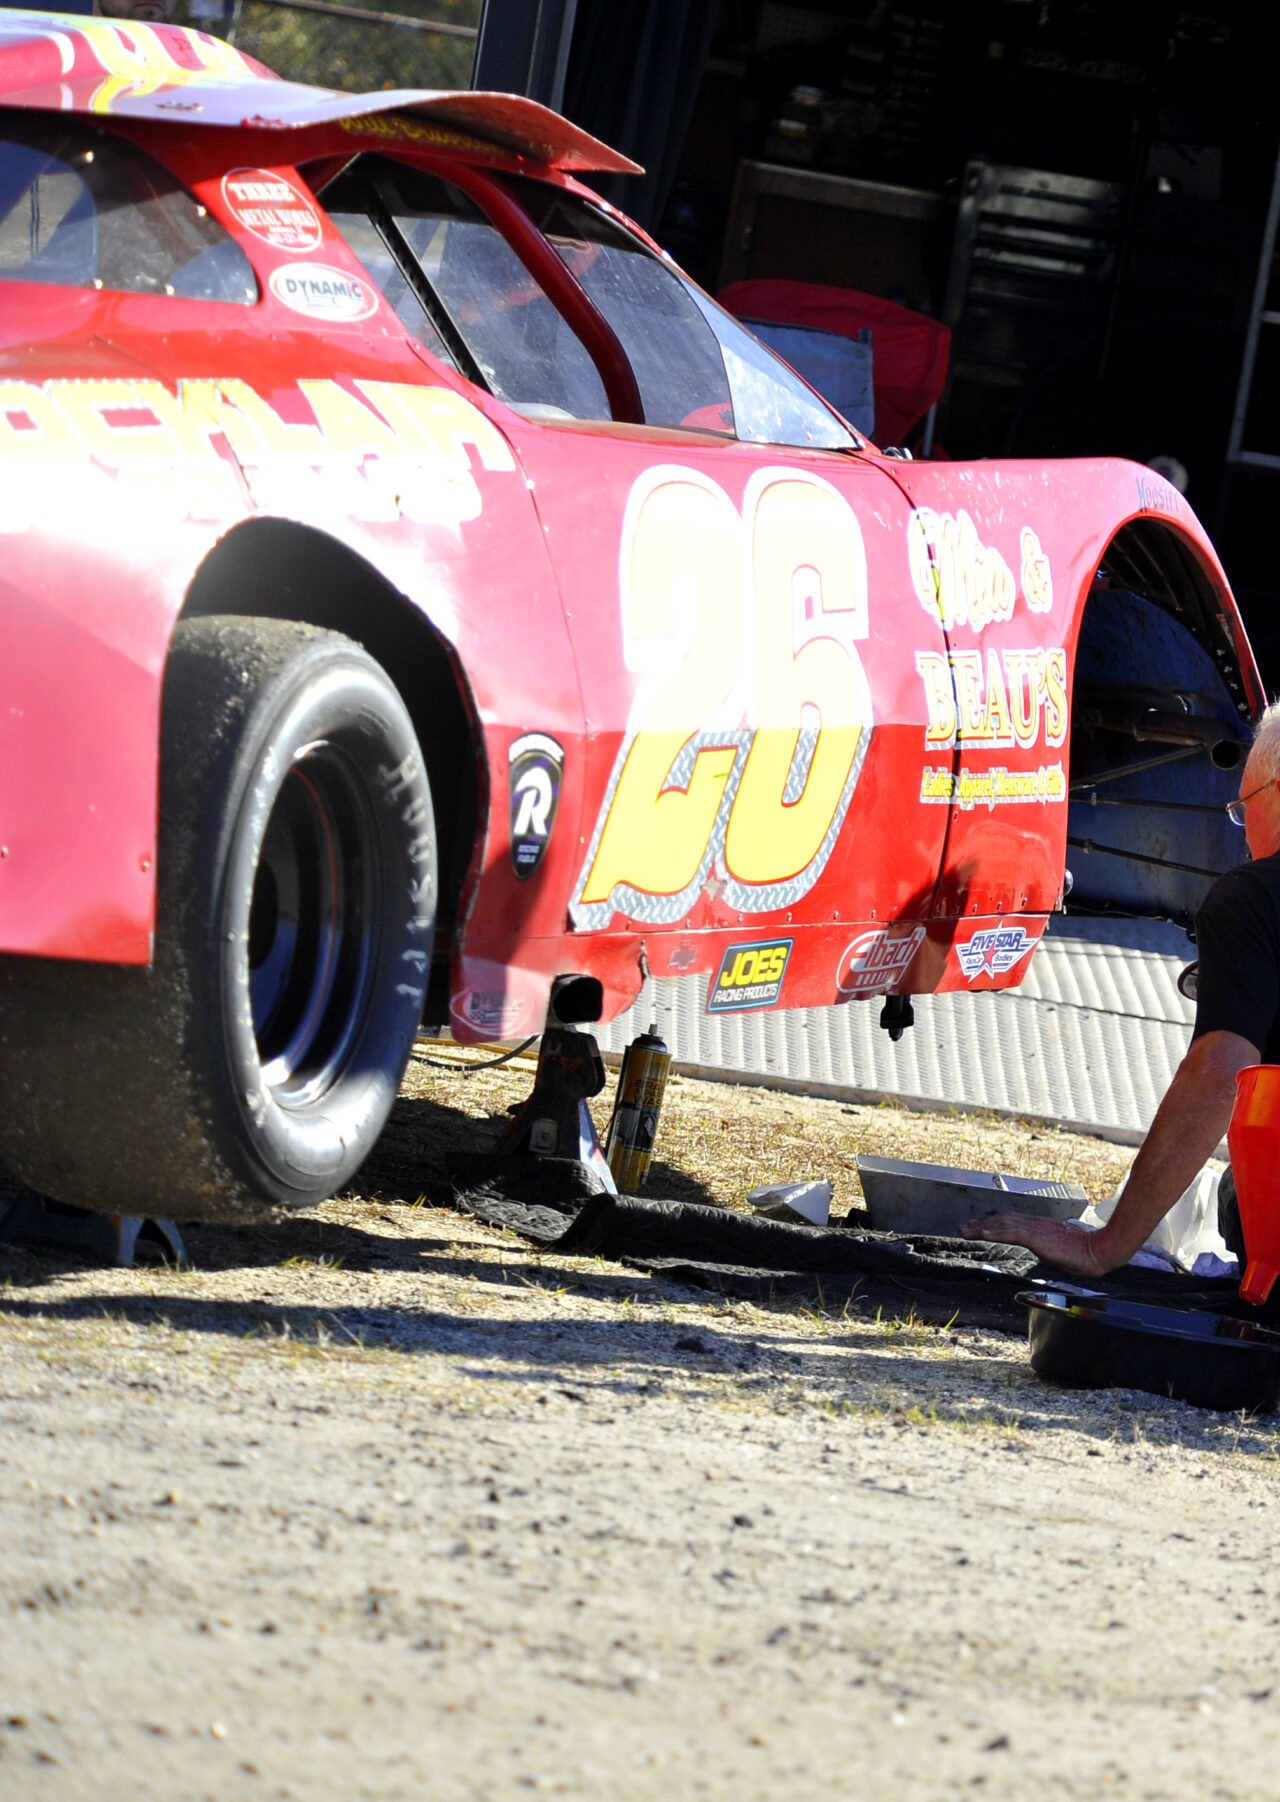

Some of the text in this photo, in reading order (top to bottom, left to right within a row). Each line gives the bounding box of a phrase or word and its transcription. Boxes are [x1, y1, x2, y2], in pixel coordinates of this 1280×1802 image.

[227, 182, 296, 201] THREE
[237, 209, 281, 226] METAL
[285, 278, 362, 298] DYNAMIC
[570, 464, 869, 931] 26
[916, 650, 1067, 746] BEAU'S
[513, 767, 550, 835] R
[842, 929, 924, 970] Eibach
[970, 932, 1023, 954] FIVE STAR
[720, 946, 788, 987] JOES
[714, 983, 779, 1003] RACING PRODUCTS
